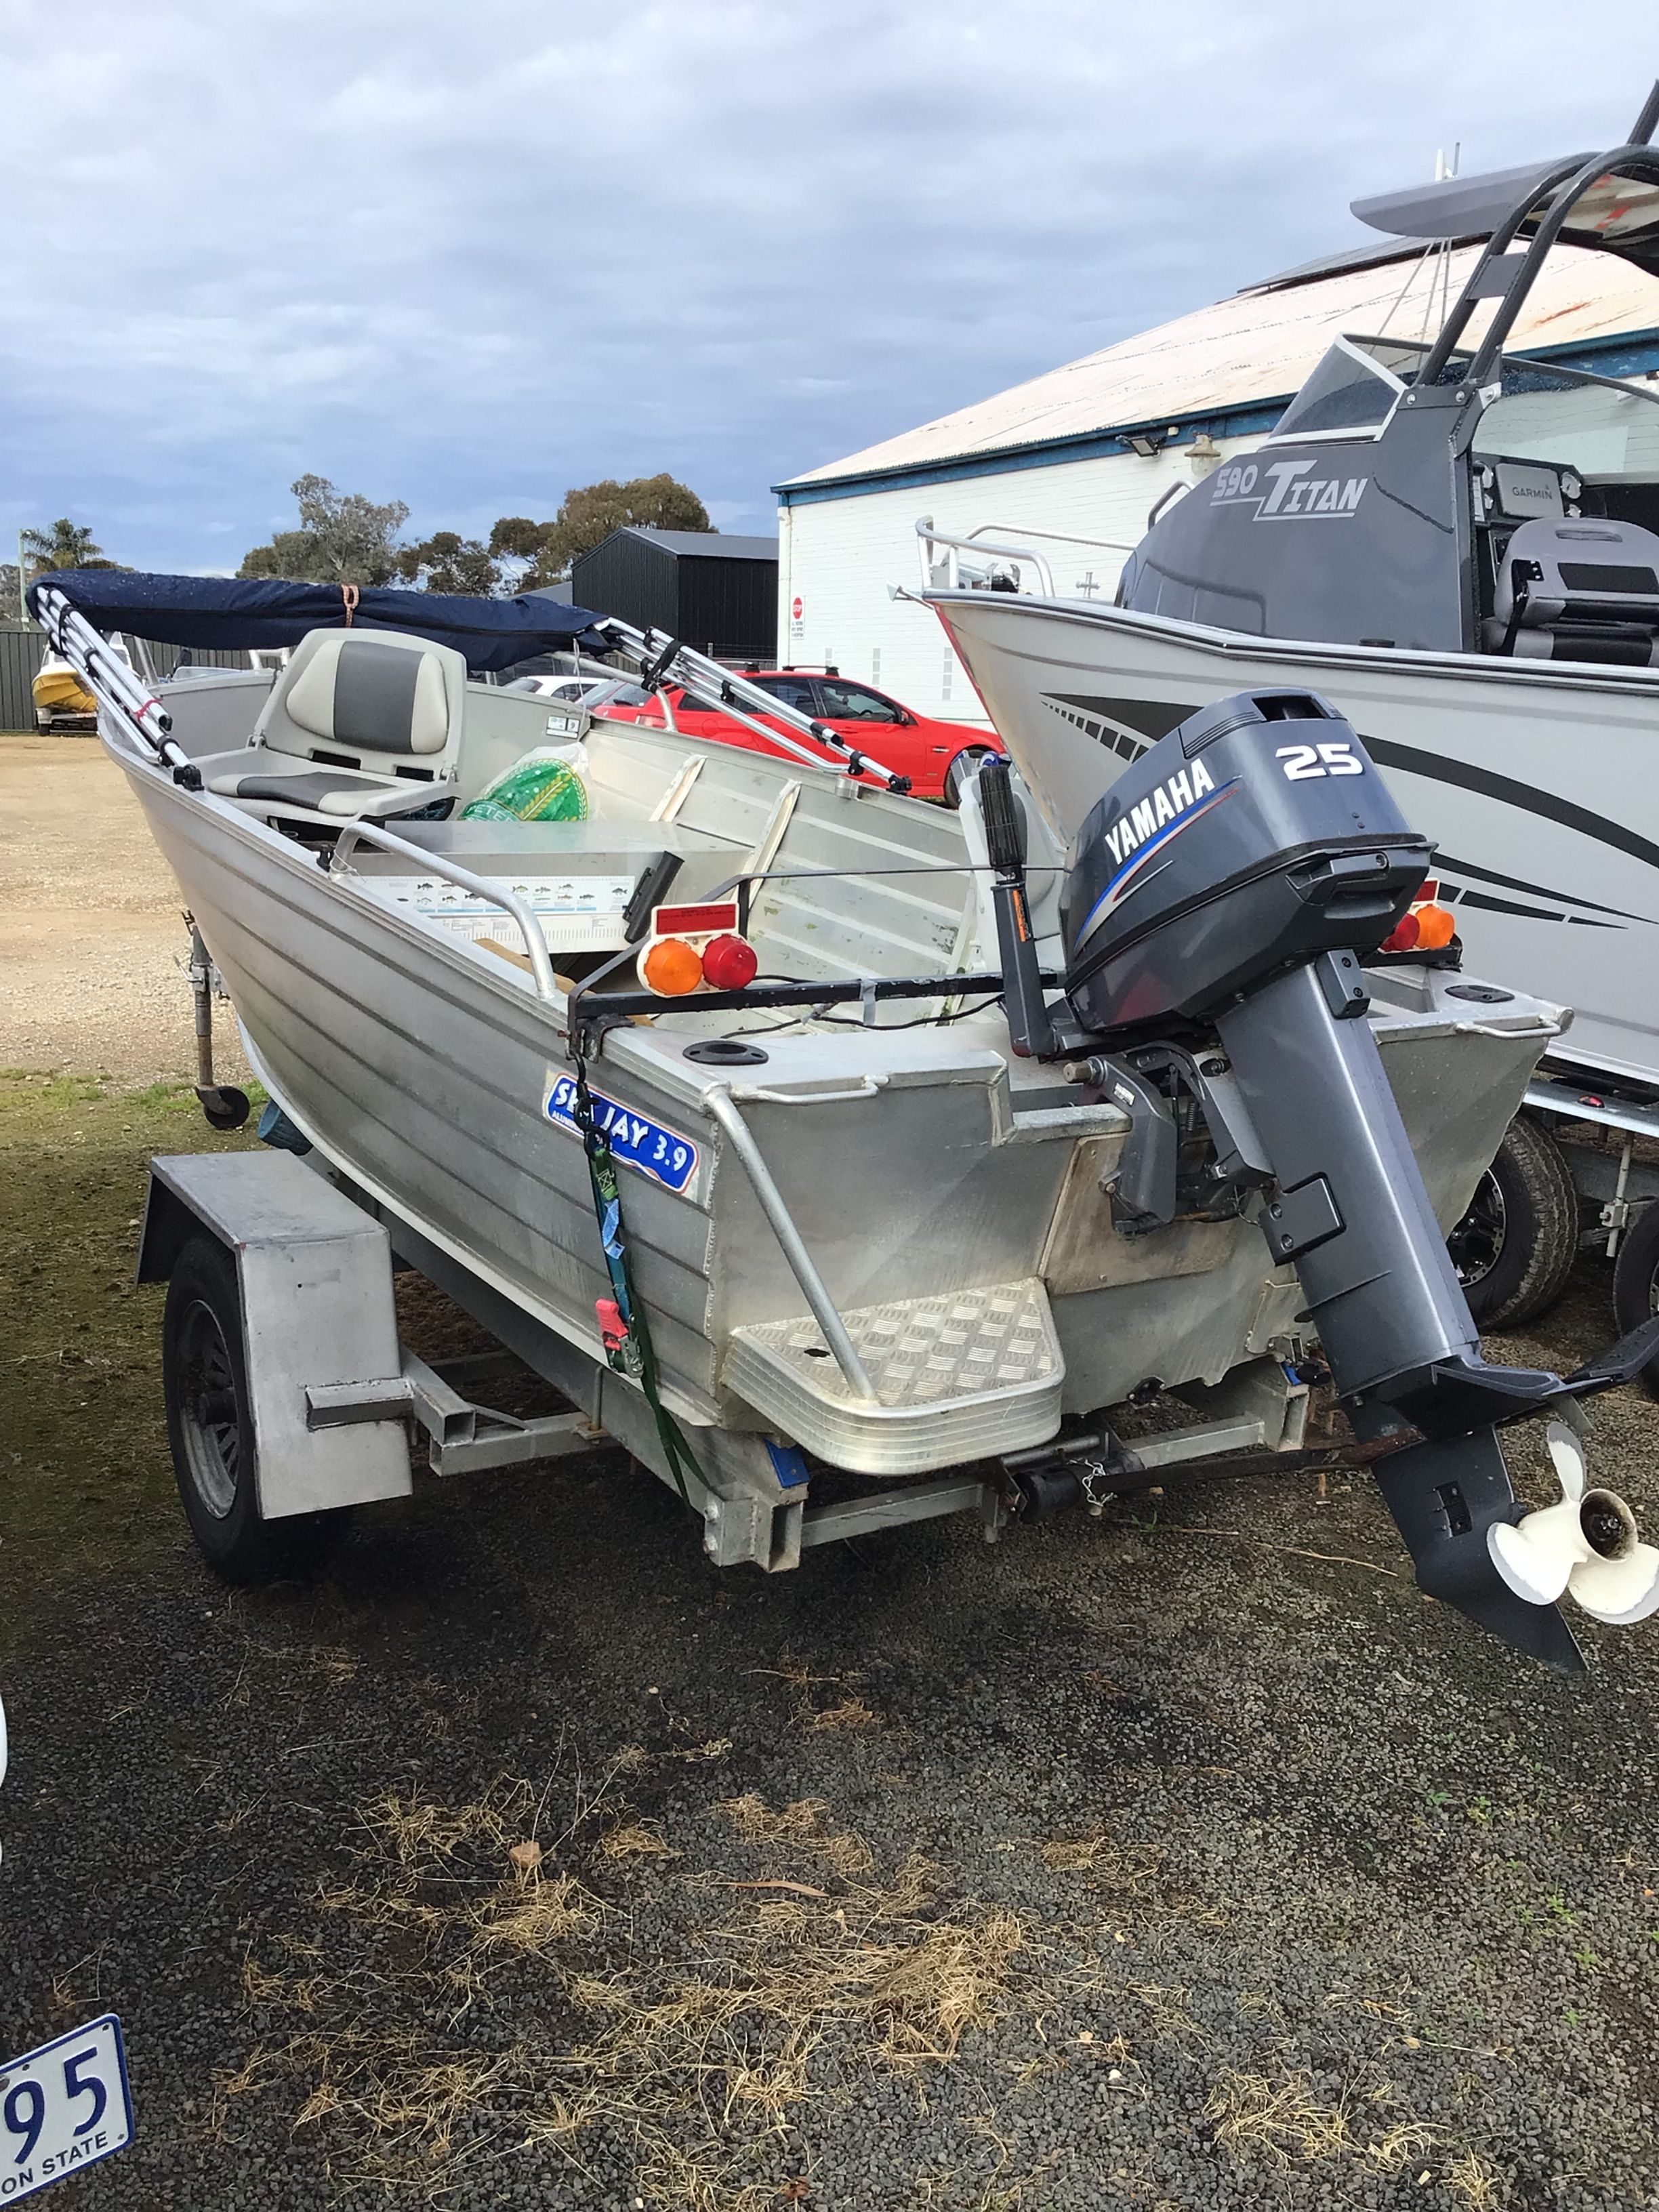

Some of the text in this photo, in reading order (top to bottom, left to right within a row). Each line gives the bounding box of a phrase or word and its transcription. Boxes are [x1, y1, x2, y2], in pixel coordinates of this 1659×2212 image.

[1212, 459, 1368, 514] 590 TITAN
[1512, 486, 1553, 499] GARMIN
[1275, 743, 1364, 781] 25
[1105, 758, 1216, 865] YAMAHA
[600, 1107, 649, 1149] JAY
[653, 1134, 688, 1172] 3.9
[4, 2047, 108, 2165] 95
[42, 2131, 108, 2175] STATE
